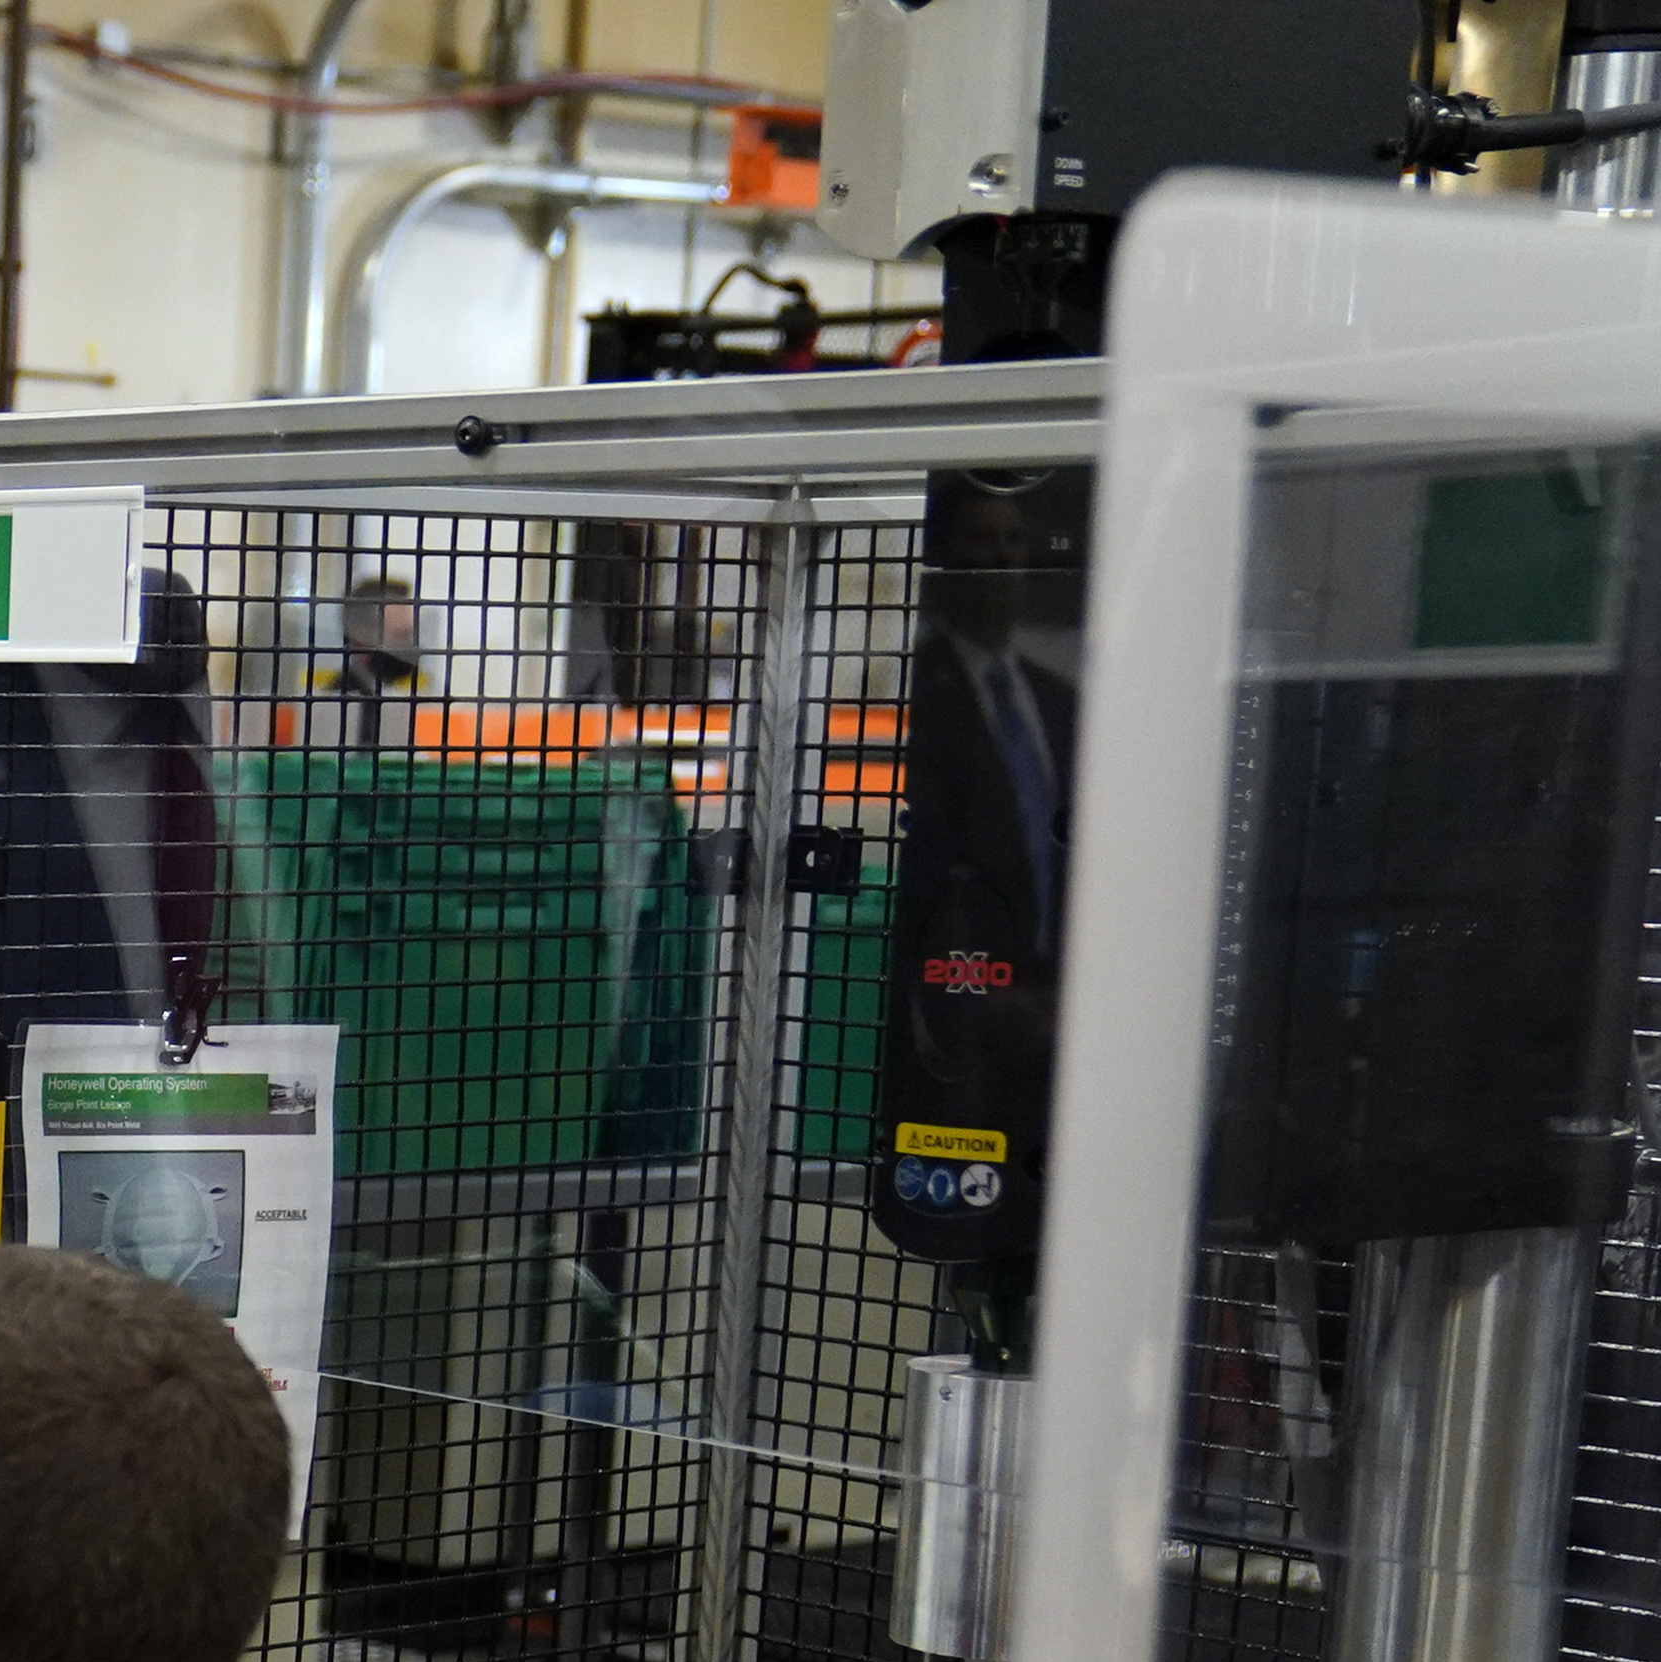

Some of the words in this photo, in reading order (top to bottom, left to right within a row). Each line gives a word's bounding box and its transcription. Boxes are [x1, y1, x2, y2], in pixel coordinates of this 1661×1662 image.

[1054, 157, 1084, 169] DOWN
[1054, 174, 1084, 188] SPEED
[48, 1077, 106, 1093] Honeywell
[108, 1077, 163, 1093] Operating
[166, 1077, 208, 1093] System
[47, 1099, 74, 1112] Single
[76, 1099, 98, 1110] Point
[923, 1135, 996, 1152] CAUTION
[255, 1209, 307, 1220] ACCEPTABLE
